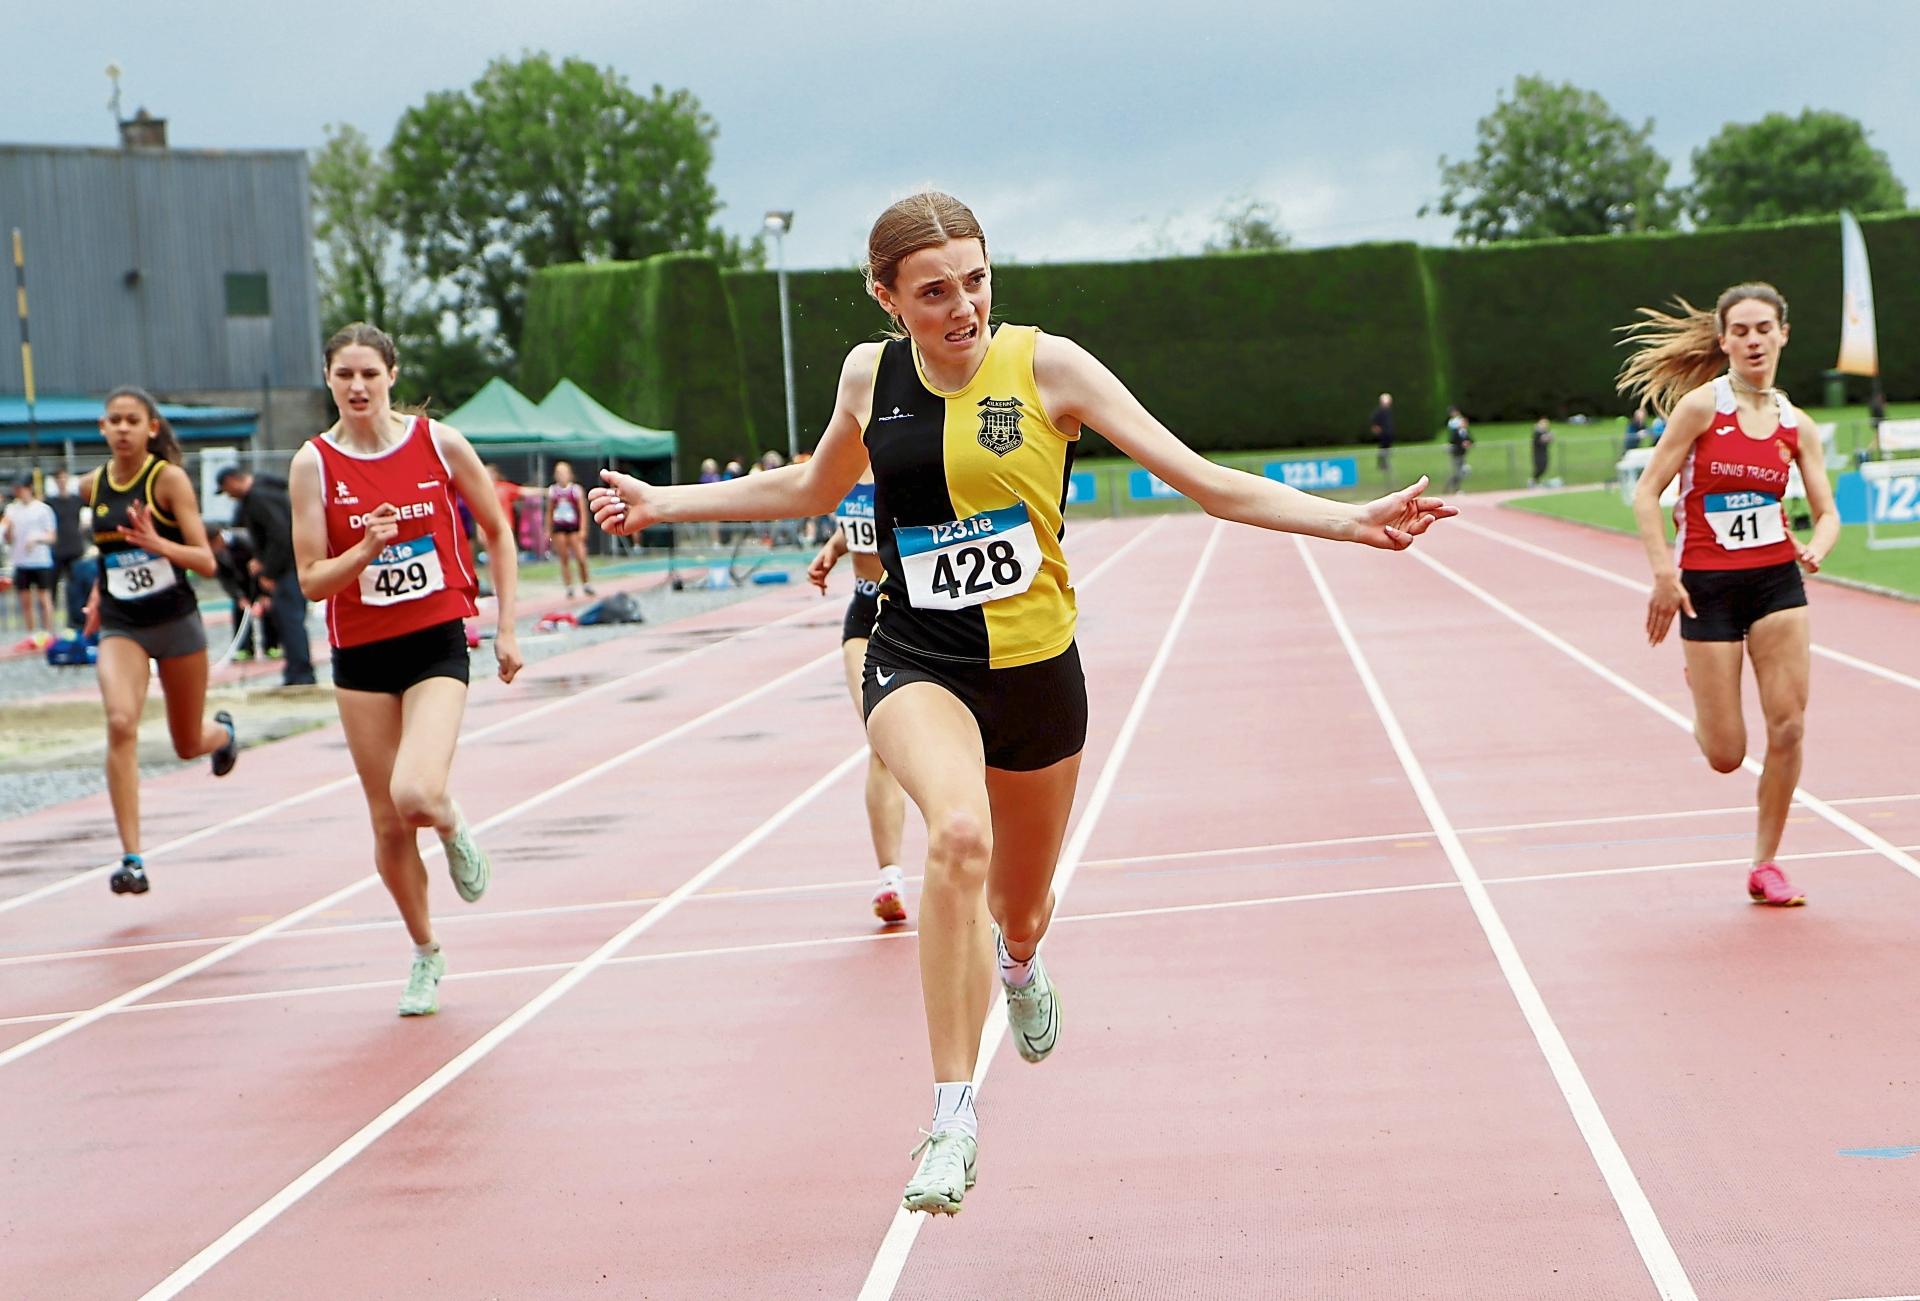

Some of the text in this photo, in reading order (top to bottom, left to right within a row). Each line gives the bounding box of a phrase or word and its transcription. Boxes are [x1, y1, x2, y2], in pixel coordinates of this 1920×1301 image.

[980, 436, 993, 447] CITY
[1282, 461, 1343, 485] 123.ie
[1710, 461, 1744, 477] ENNIS
[1746, 465, 1778, 482] TRACK
[1724, 492, 1765, 509] 123.ie
[349, 501, 434, 529] DOEEN
[1729, 512, 1758, 541] 41
[928, 518, 993, 544] 123.ie
[125, 567, 153, 591] 38
[375, 562, 427, 597] 429
[932, 540, 1021, 599] 428
